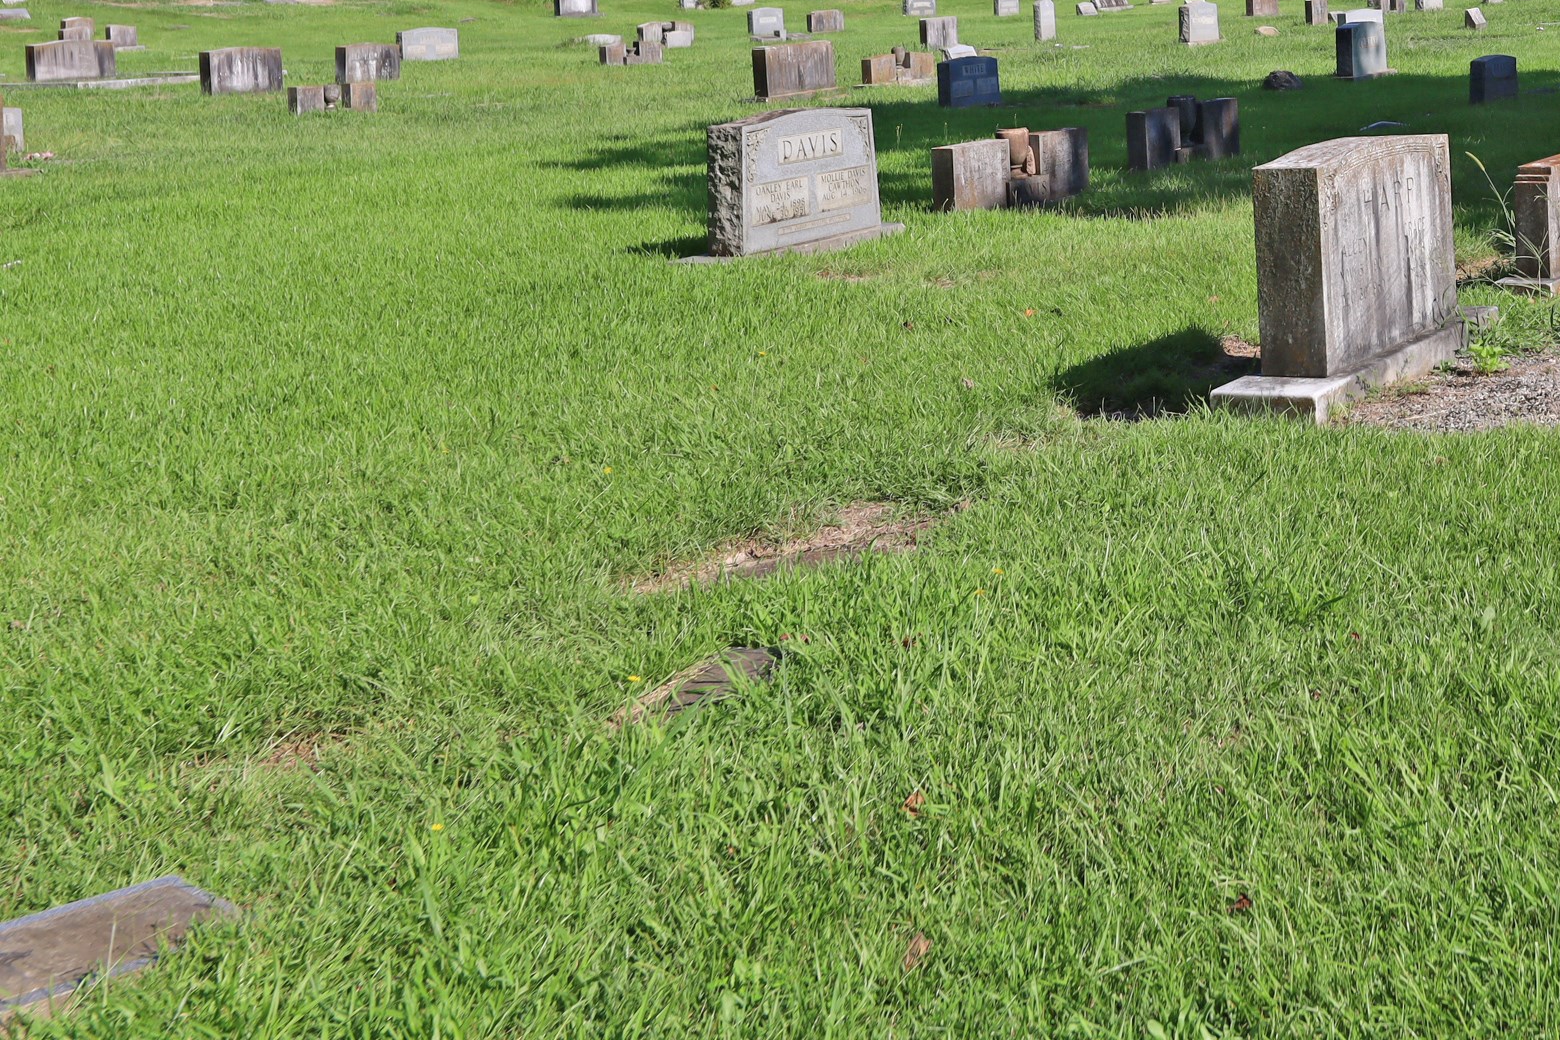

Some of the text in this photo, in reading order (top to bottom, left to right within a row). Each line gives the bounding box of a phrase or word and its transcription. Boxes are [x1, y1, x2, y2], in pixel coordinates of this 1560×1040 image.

[783, 132, 838, 162] DAVIS
[821, 167, 866, 183] MOLLIE DAVIS
[756, 179, 803, 196] OAKLEY EARL
[828, 178, 860, 192] CAWTHON
[770, 191, 791, 203] DAVIS
[1363, 176, 1414, 211] HARP
